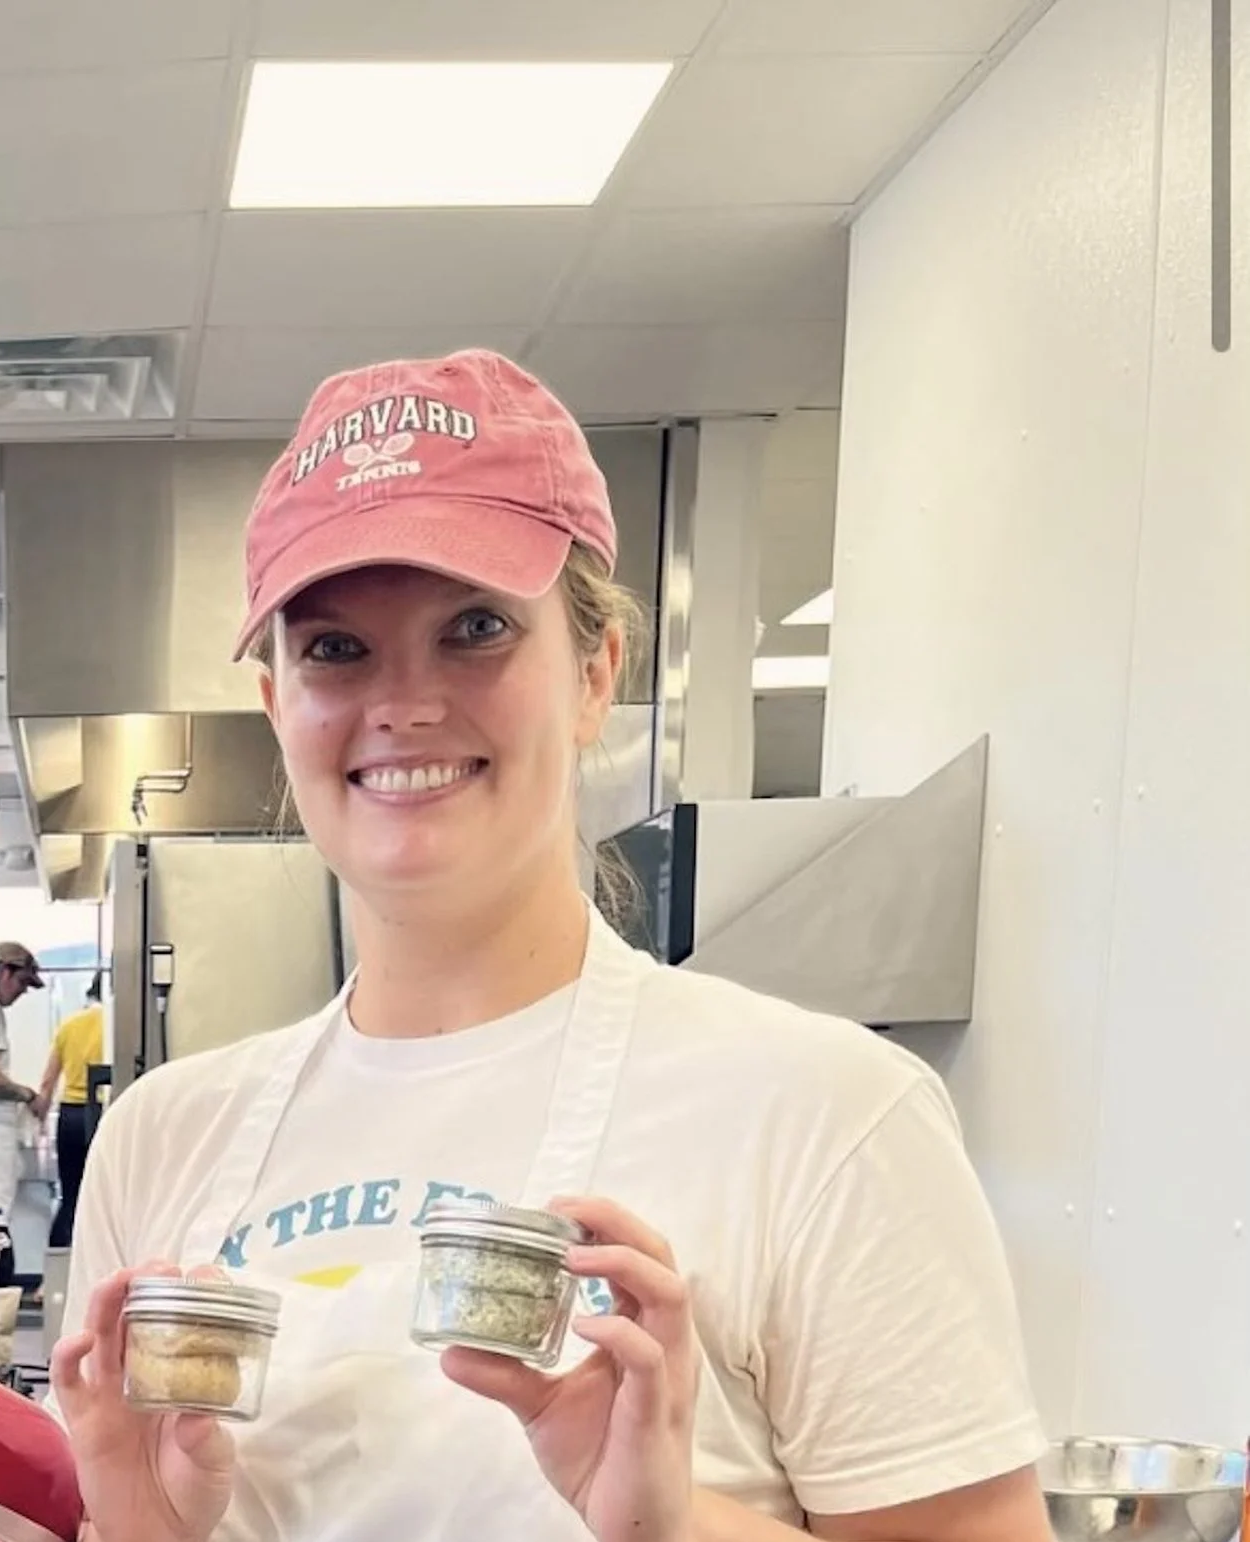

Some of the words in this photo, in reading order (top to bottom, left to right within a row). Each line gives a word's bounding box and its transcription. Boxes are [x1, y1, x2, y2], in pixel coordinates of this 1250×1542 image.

[292, 395, 478, 484] HARVARD
[335, 460, 421, 491] TENNIS
[266, 1178, 401, 1248] THE
